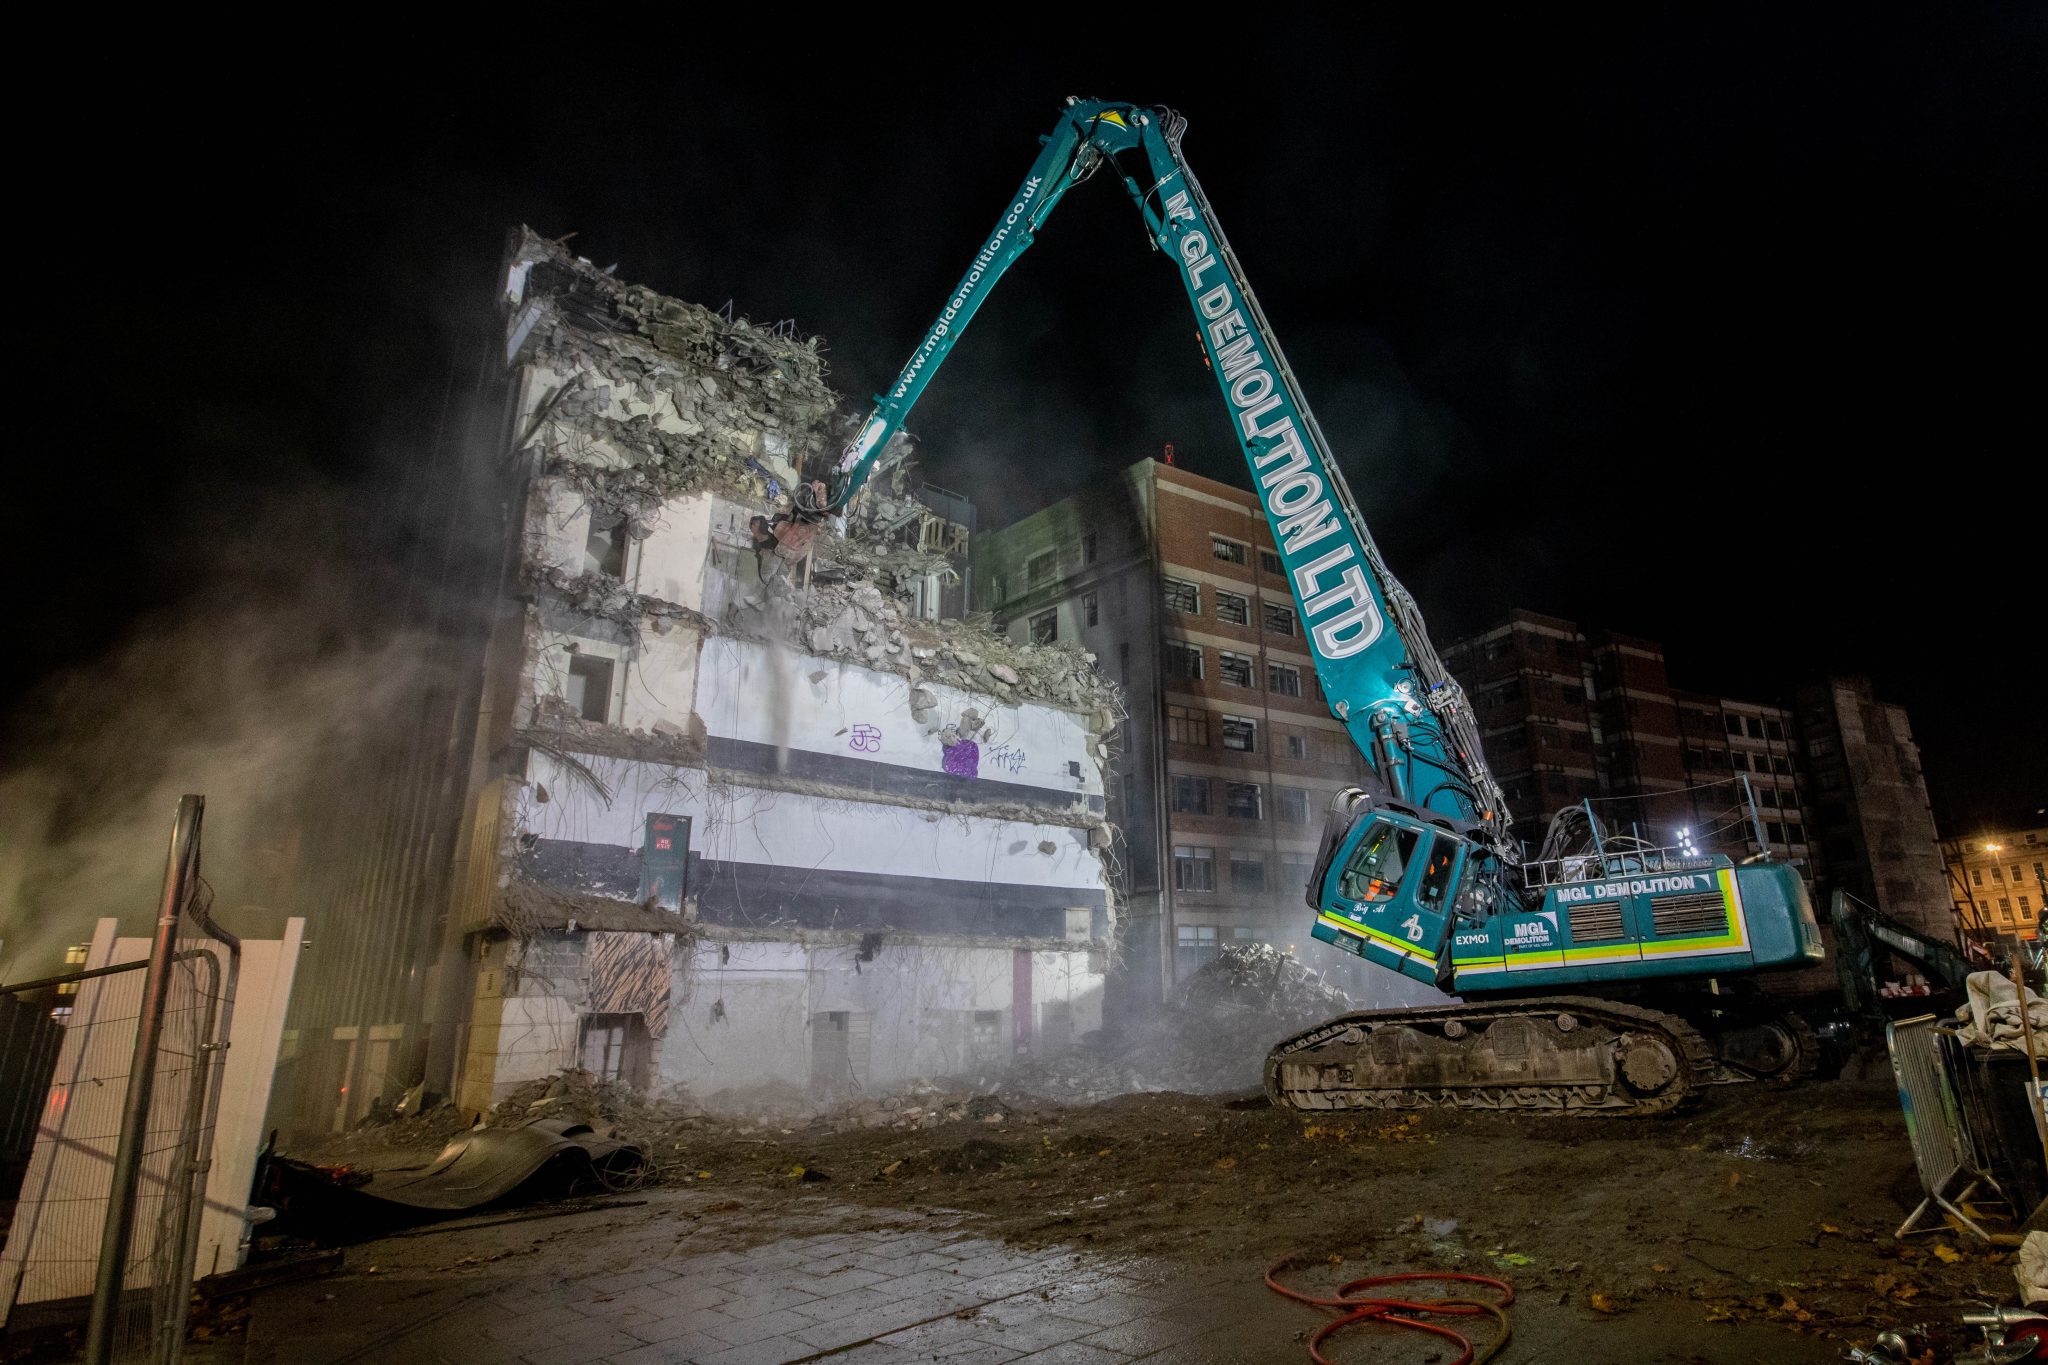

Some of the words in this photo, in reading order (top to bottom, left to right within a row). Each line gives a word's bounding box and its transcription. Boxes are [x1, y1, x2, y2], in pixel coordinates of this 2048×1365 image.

[893, 175, 1042, 400] www.mgldemolition.co.uk
[1197, 282, 1340, 556] DEMOLITION
[1293, 542, 1384, 660] LTD
[1557, 887, 1591, 902] MGL
[1594, 874, 1695, 899] DEMOLITION
[1353, 902, 1369, 915] Big
[1504, 935, 1550, 945] DEMOLITION
[1514, 922, 1549, 937] MGL
